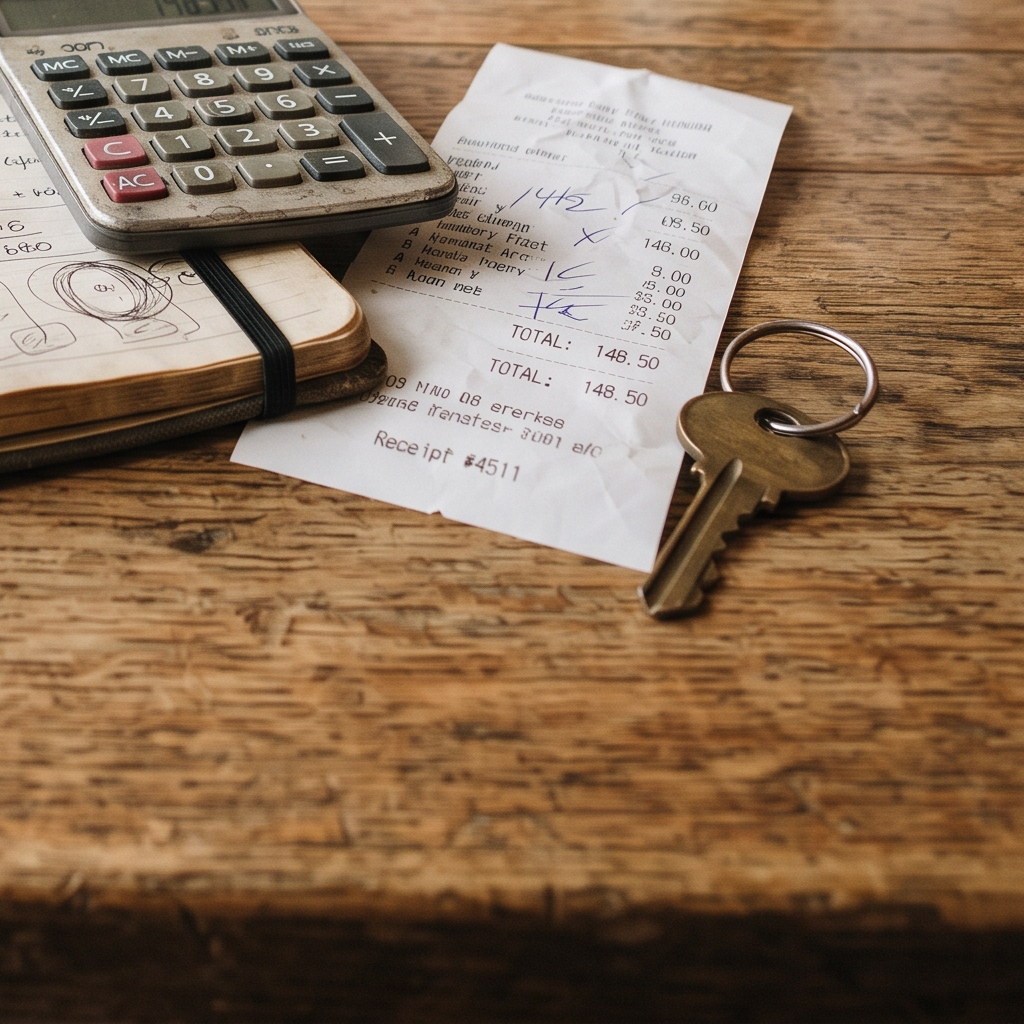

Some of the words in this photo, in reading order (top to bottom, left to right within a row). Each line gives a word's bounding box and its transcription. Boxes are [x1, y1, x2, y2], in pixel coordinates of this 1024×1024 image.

[42, 60, 79, 71] MC
[107, 53, 142, 65] MC
[130, 78, 149, 92] 7
[193, 72, 215, 86] 8
[254, 67, 274, 81] 9
[154, 106, 174, 120] 4
[217, 100, 235, 114] 5
[277, 95, 297, 109] 6
[103, 141, 132, 155] C
[175, 135, 190, 150] 1
[236, 128, 260, 143] 2
[297, 123, 321, 138] 3
[116, 173, 155, 190] AC
[193, 165, 215, 181] 0
[511, 323, 572, 351] TOTAL:
[489, 358, 553, 387] TOTAL:
[374, 429, 454, 464] Receipt
